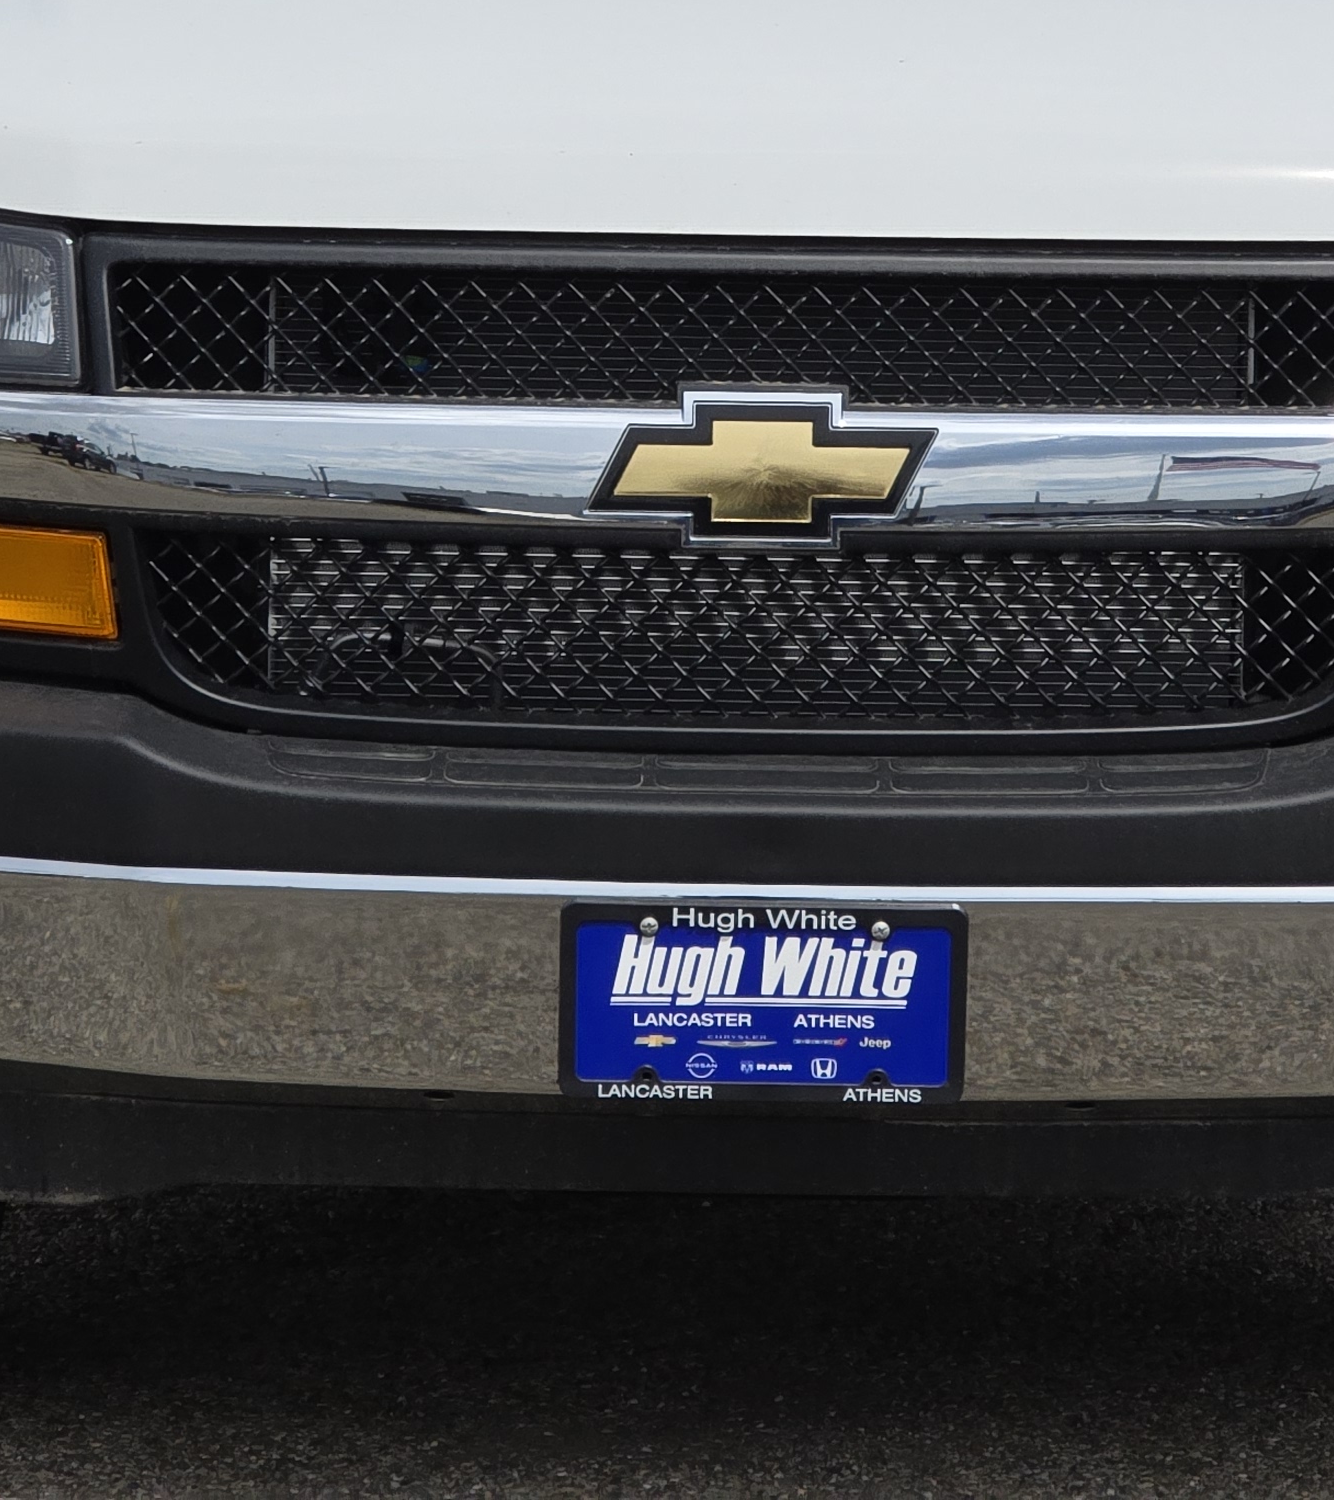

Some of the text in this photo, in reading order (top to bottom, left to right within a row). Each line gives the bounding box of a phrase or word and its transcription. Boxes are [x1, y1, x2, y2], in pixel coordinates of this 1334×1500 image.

[671, 907, 857, 932] Hugh White
[612, 933, 918, 1006] Hugh White
[633, 1012, 875, 1030] LANCASTER ATHENS
[858, 1036, 892, 1050] Jeep
[756, 1063, 793, 1072] RAM
[597, 1084, 713, 1100] LANCASTER
[842, 1087, 922, 1104] ATHENS
